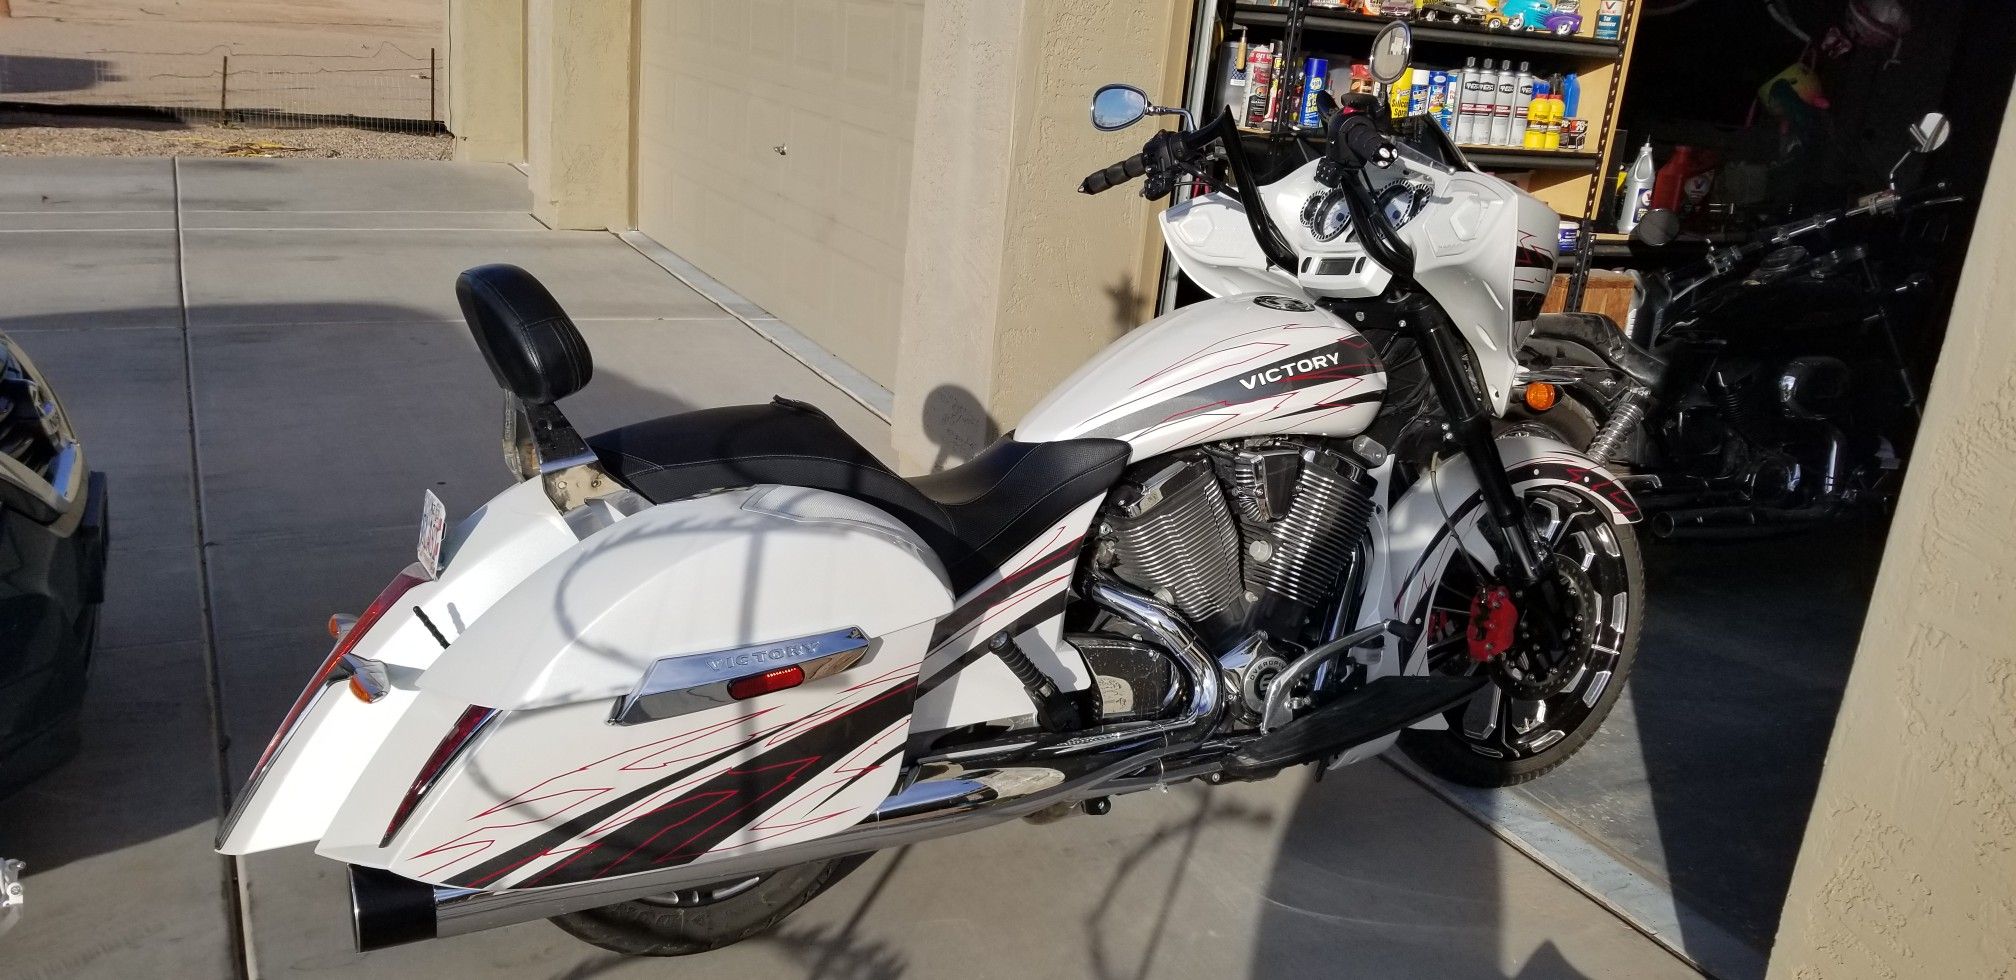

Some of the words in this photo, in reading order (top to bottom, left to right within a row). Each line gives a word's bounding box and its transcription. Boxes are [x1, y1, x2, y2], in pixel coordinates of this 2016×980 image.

[1239, 352, 1339, 390] VICTORY
[706, 641, 824, 671] VICTORY
[1249, 660, 1287, 681] OVERDRIV
